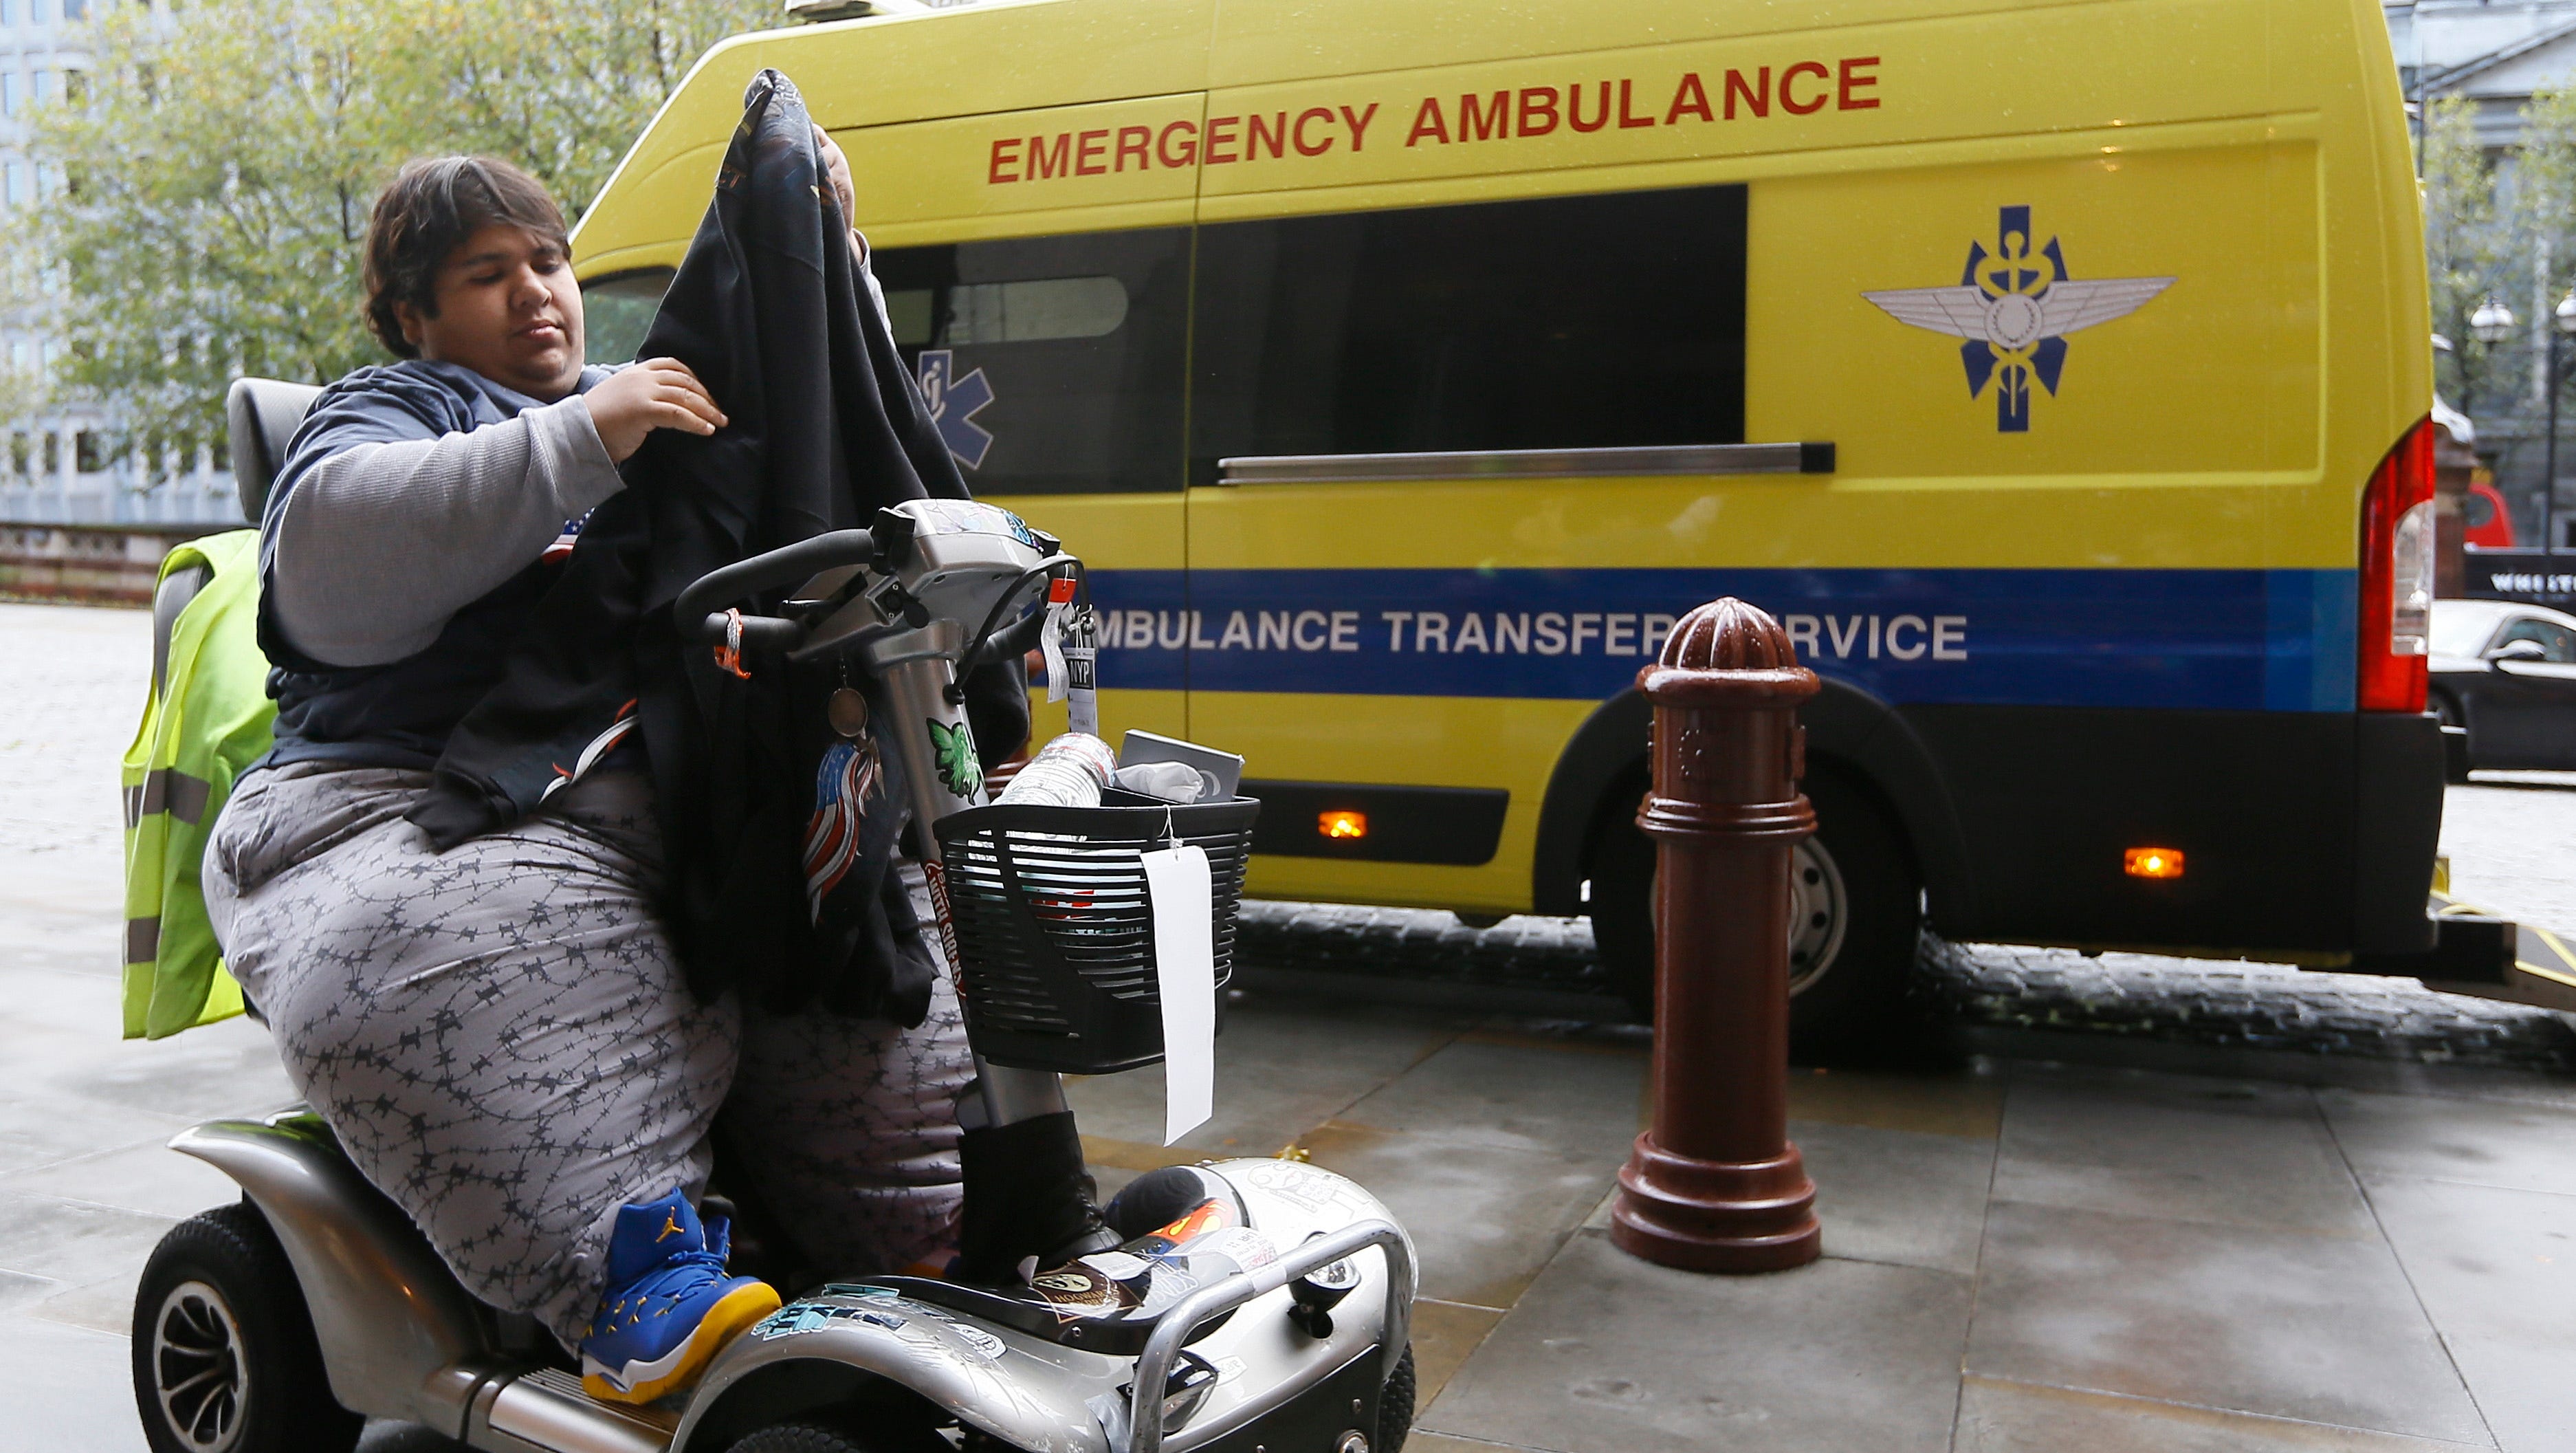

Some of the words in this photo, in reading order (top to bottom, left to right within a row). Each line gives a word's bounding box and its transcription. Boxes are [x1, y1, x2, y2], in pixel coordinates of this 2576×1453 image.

[988, 102, 1379, 184] EMERGENCY
[1405, 56, 1881, 147] AMBULANCE
[1091, 609, 1360, 651] MBULANCE
[1381, 611, 1677, 657] TRANSFER
[1772, 613, 1968, 662] RVICE
[1070, 660, 1090, 684] NYP
